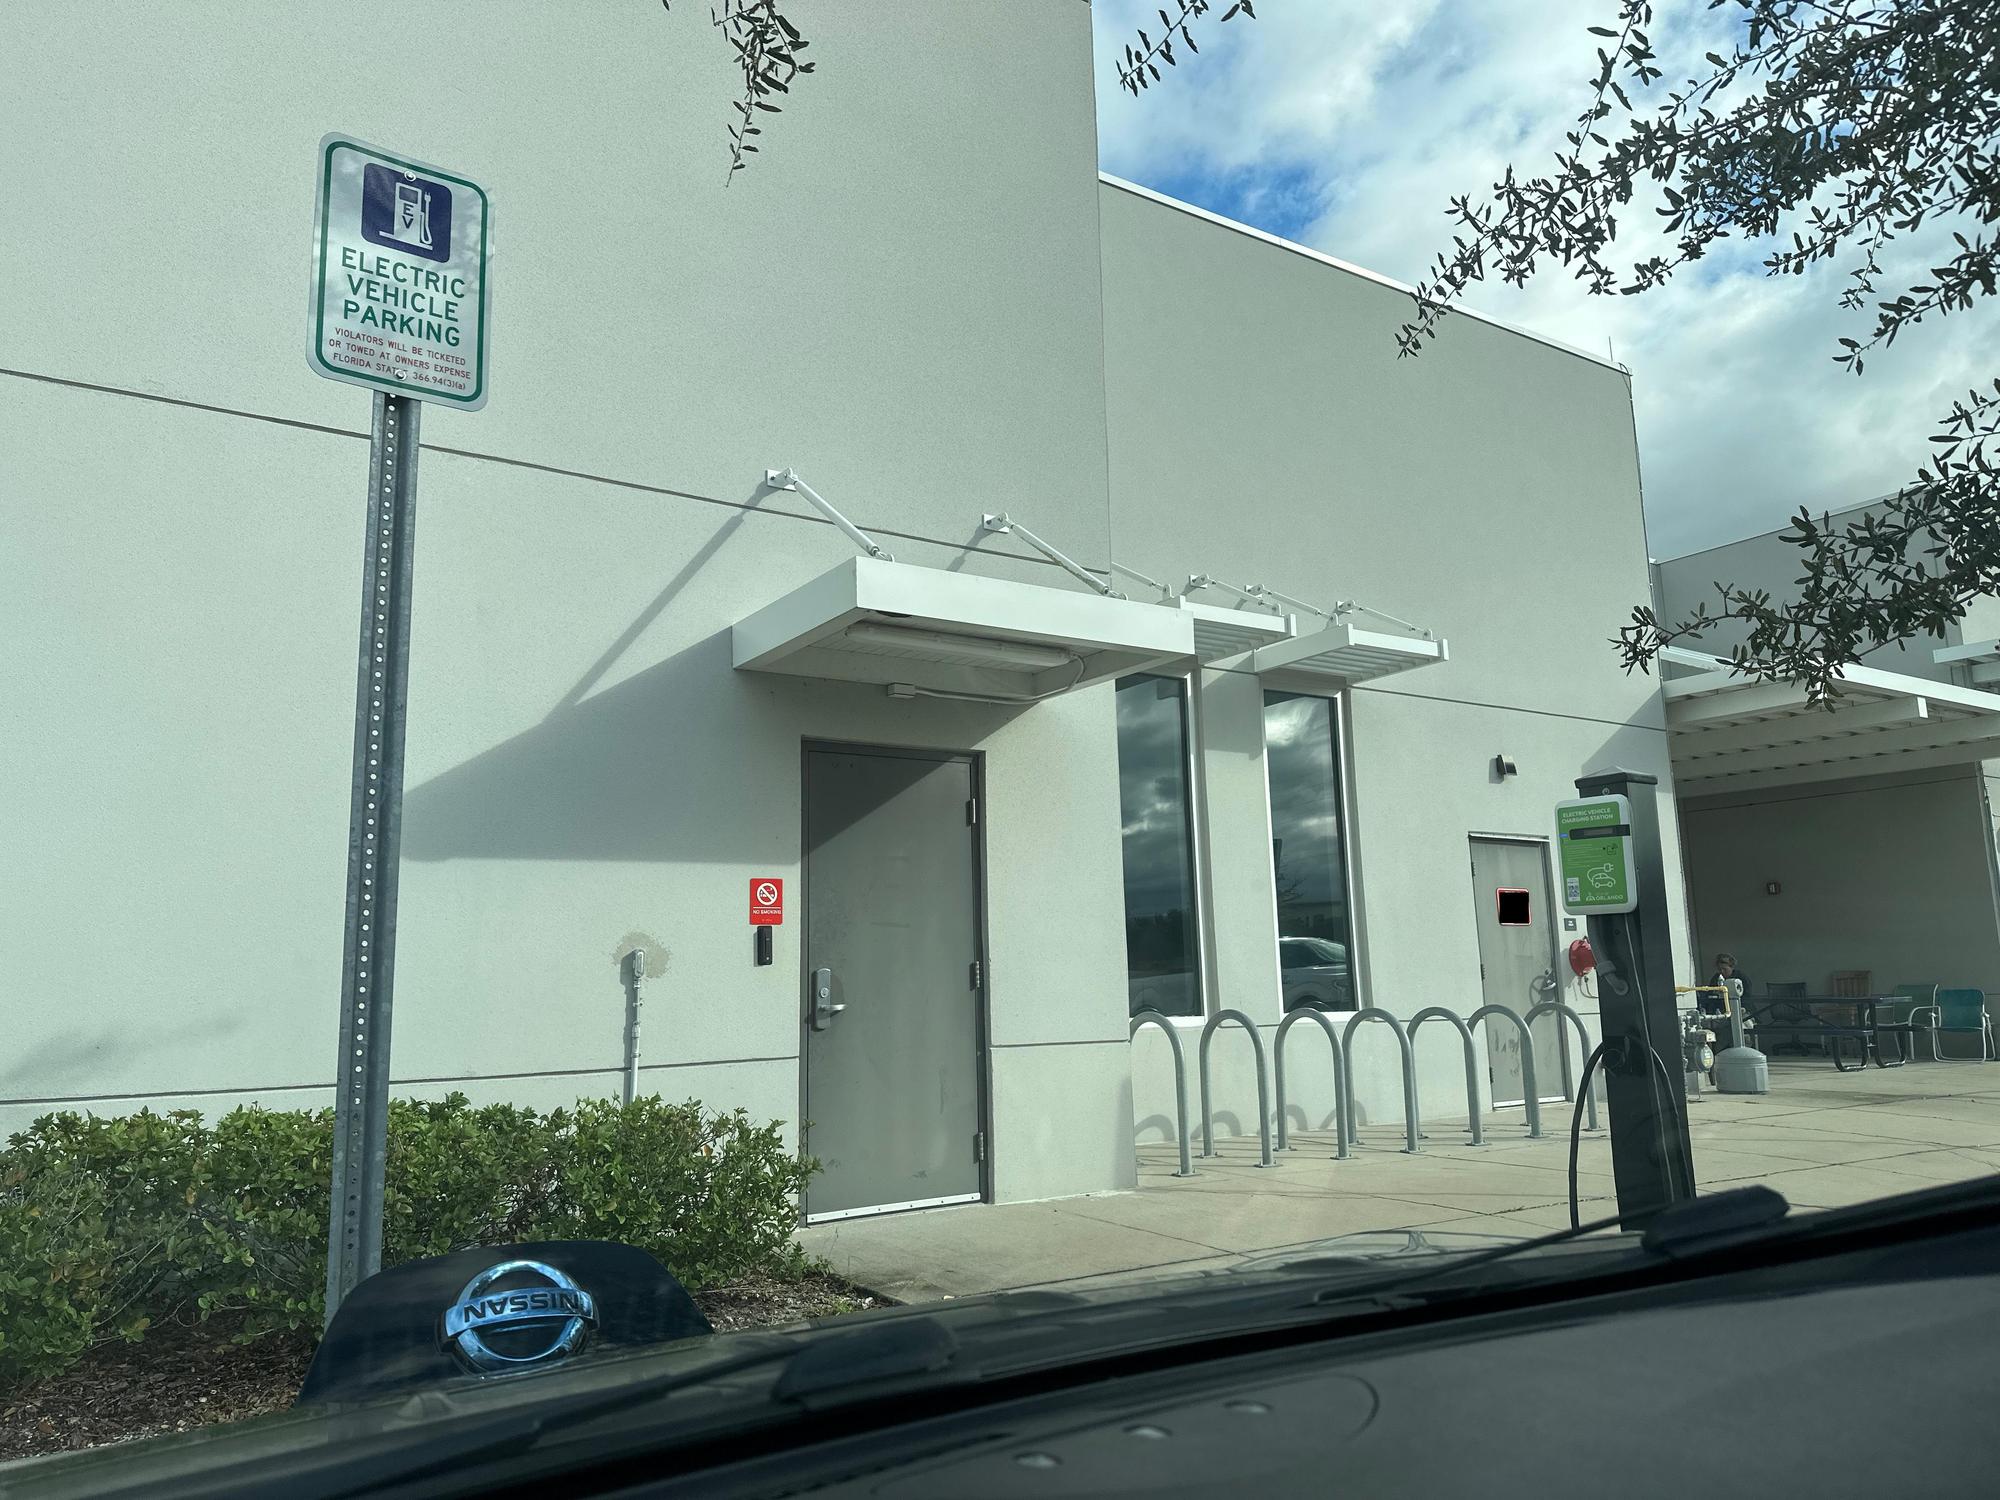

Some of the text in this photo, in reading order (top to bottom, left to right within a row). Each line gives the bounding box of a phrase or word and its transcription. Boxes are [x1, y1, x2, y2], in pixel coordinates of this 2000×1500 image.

[342, 246, 465, 298] ELECTRIC
[347, 274, 459, 322] VEHICLE
[343, 299, 460, 347] PARKING
[329, 339, 471, 379] OR TOWED AT OWNERS EXPENSE
[333, 352, 372, 369] FLORIDA
[335, 327, 466, 366] VIOLATORS WILL BE TICKETED
[1562, 816, 1589, 824] CHARGING
[1588, 807, 1611, 815] VEHICLE
[463, 1292, 579, 1323] NISSAN
